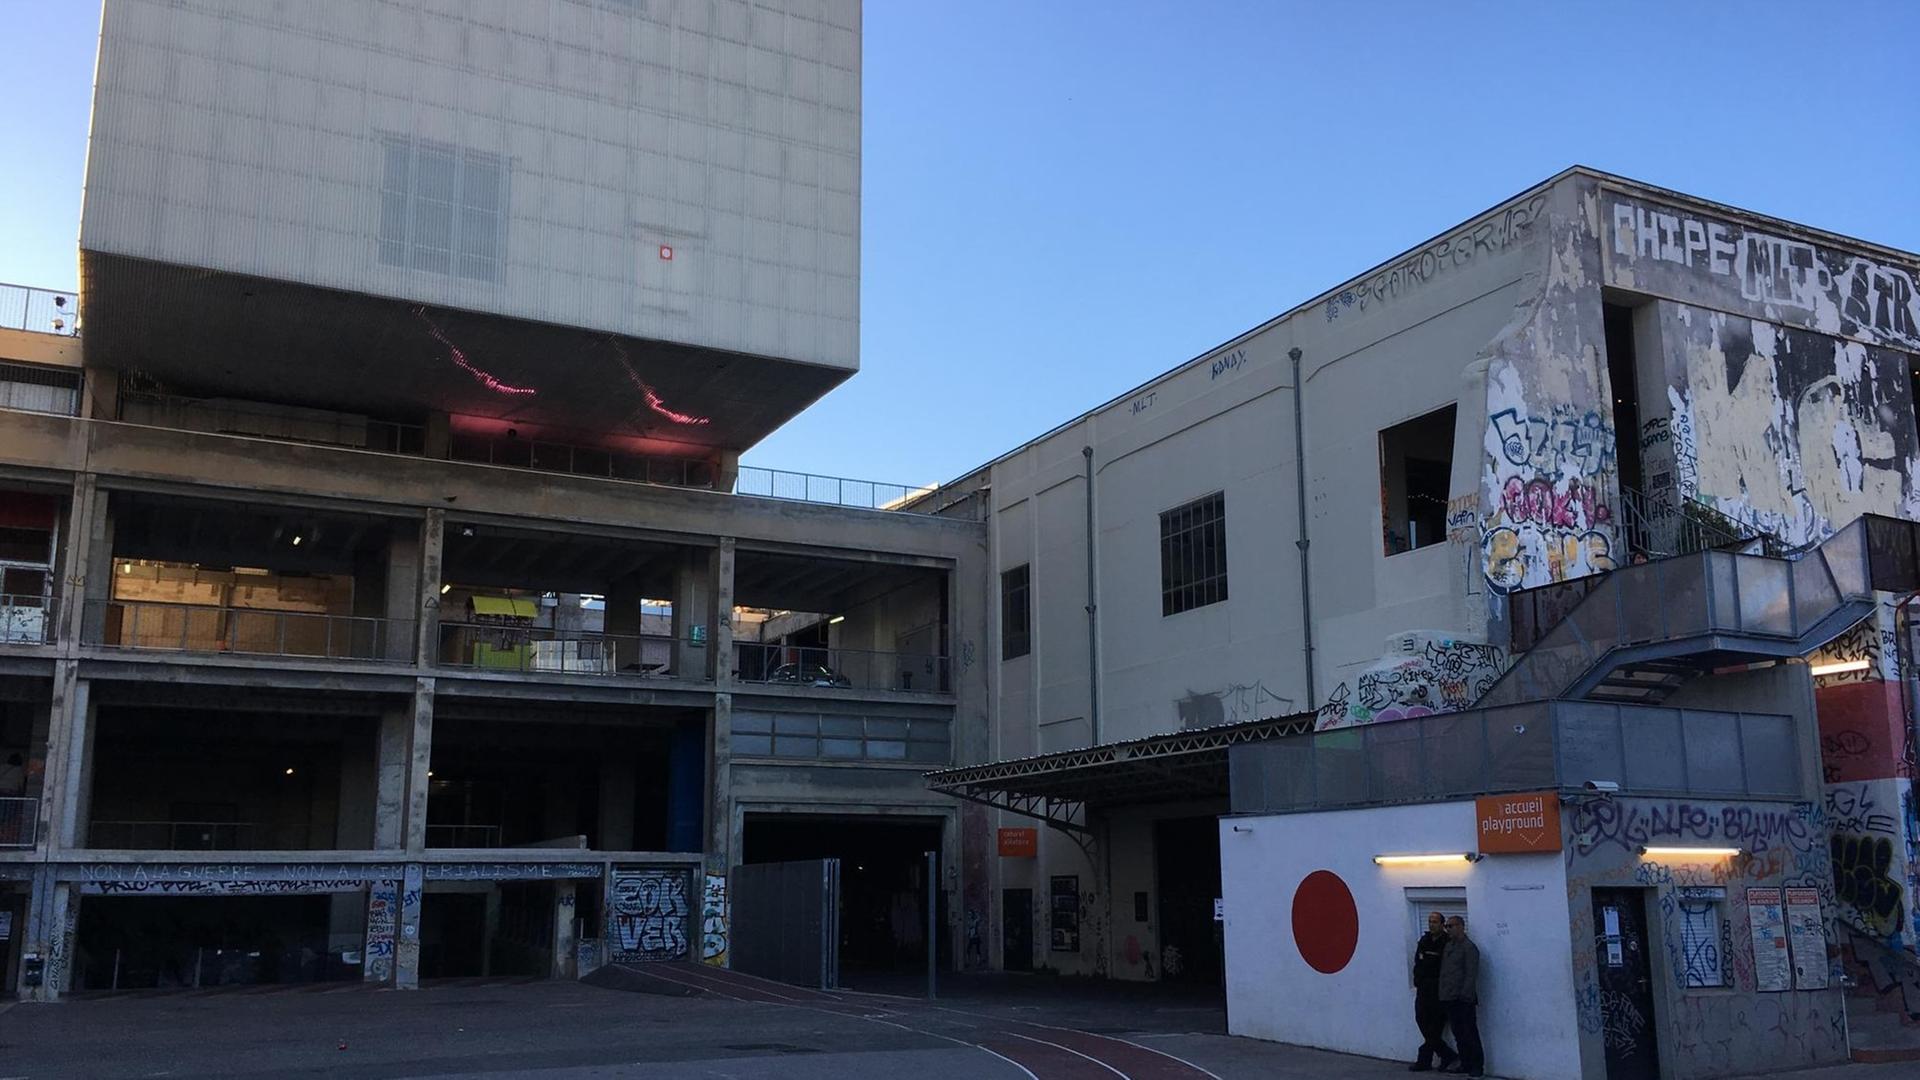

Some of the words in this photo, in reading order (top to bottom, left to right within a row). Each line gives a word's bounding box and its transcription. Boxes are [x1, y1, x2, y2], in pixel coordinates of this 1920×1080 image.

[1504, 797, 1543, 814] accueil
[1482, 813, 1544, 834] playground
[80, 864, 122, 880] NON
[133, 864, 148, 880] A
[152, 865, 170, 880] LA
[177, 864, 257, 879] GUERRE
[284, 864, 325, 879] NON
[338, 864, 350, 879] A
